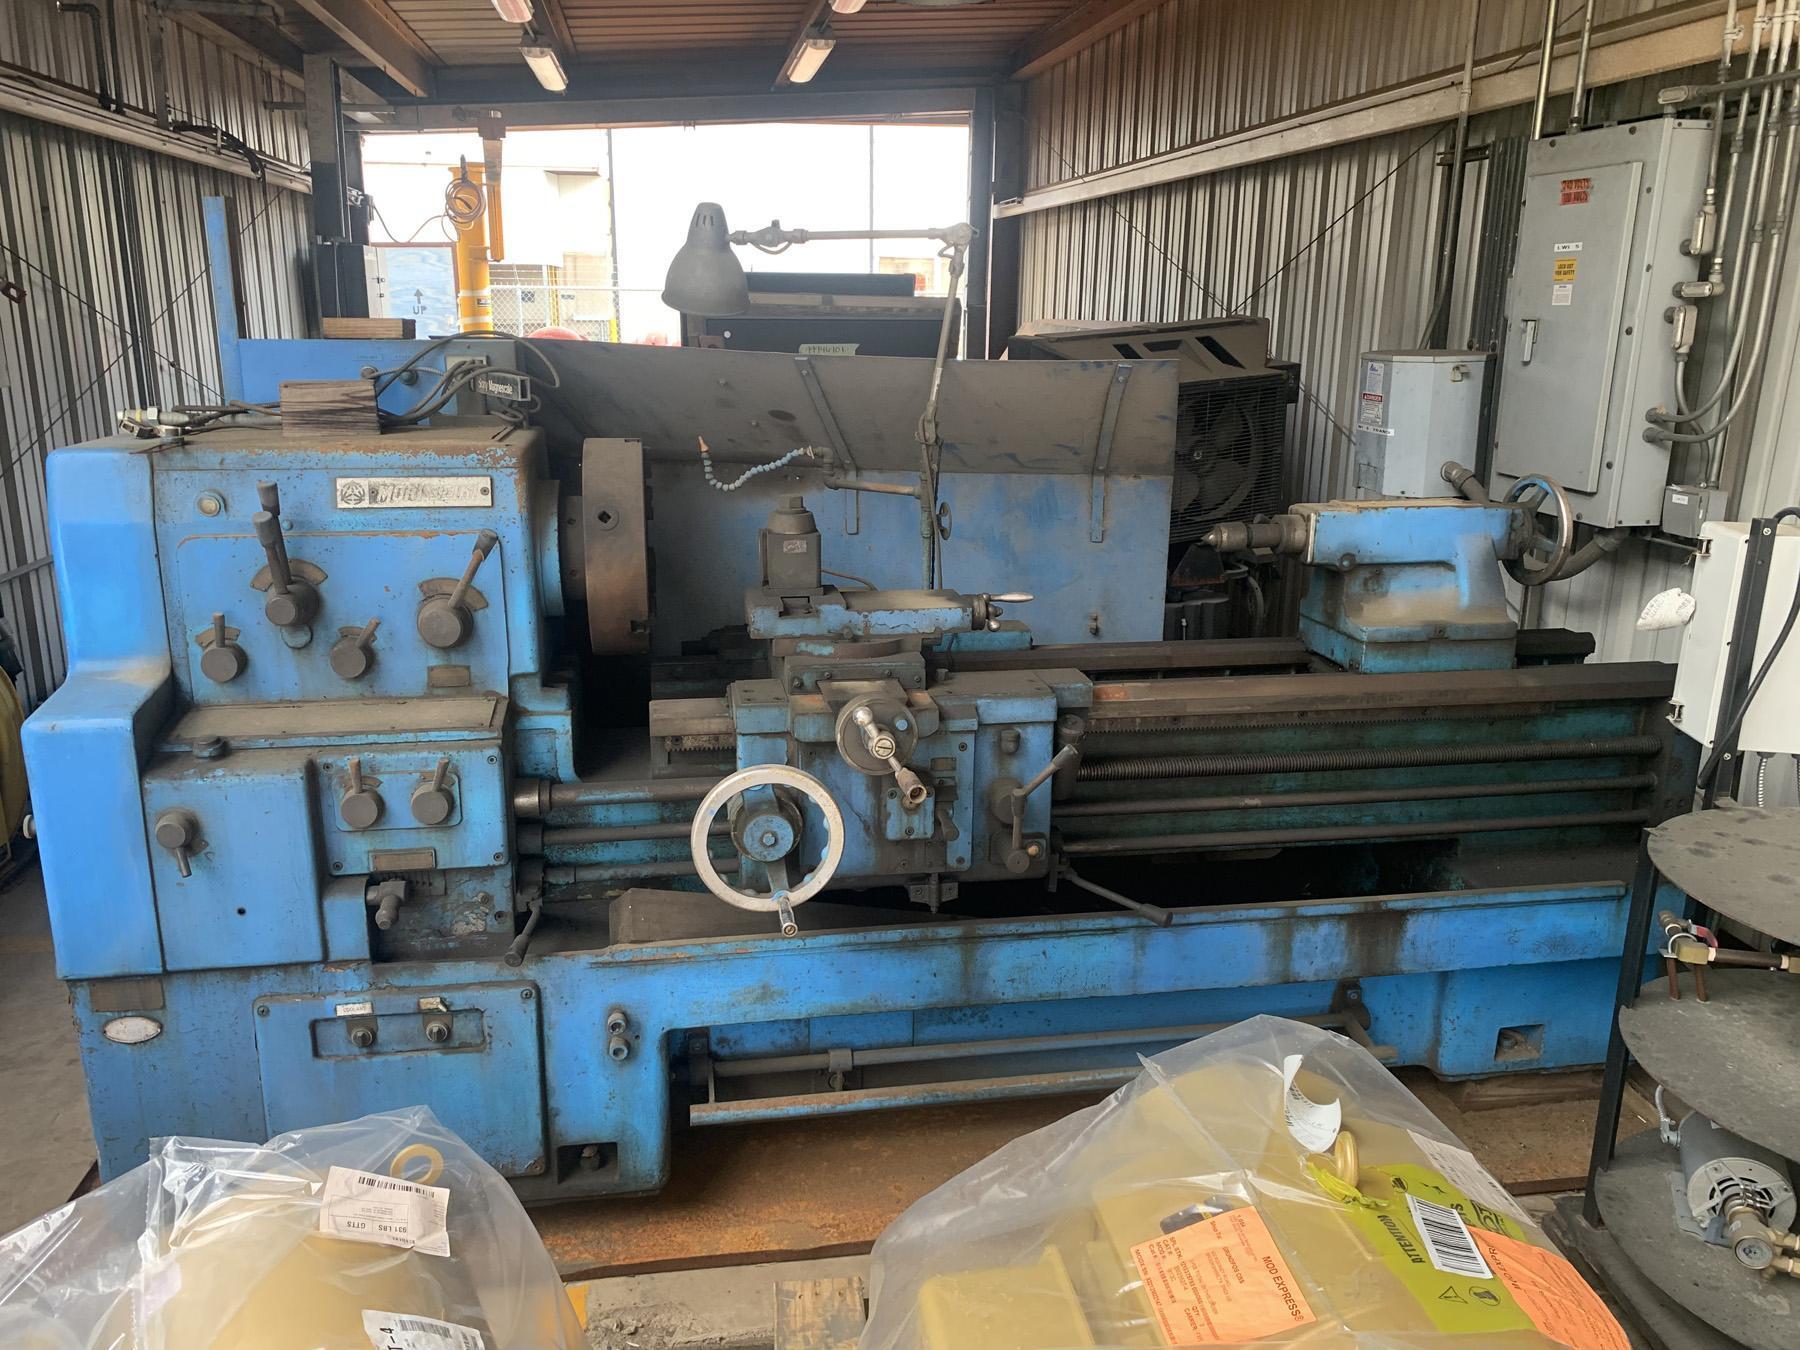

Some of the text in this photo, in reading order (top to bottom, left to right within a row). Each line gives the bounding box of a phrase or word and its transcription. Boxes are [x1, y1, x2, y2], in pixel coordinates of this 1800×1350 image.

[412, 306, 428, 316] UP
[488, 379, 513, 395] Magnescale
[378, 1225, 392, 1233] LBS
[1377, 1215, 1427, 1264] ATTENTION
[1262, 1254, 1278, 1276] MOD
